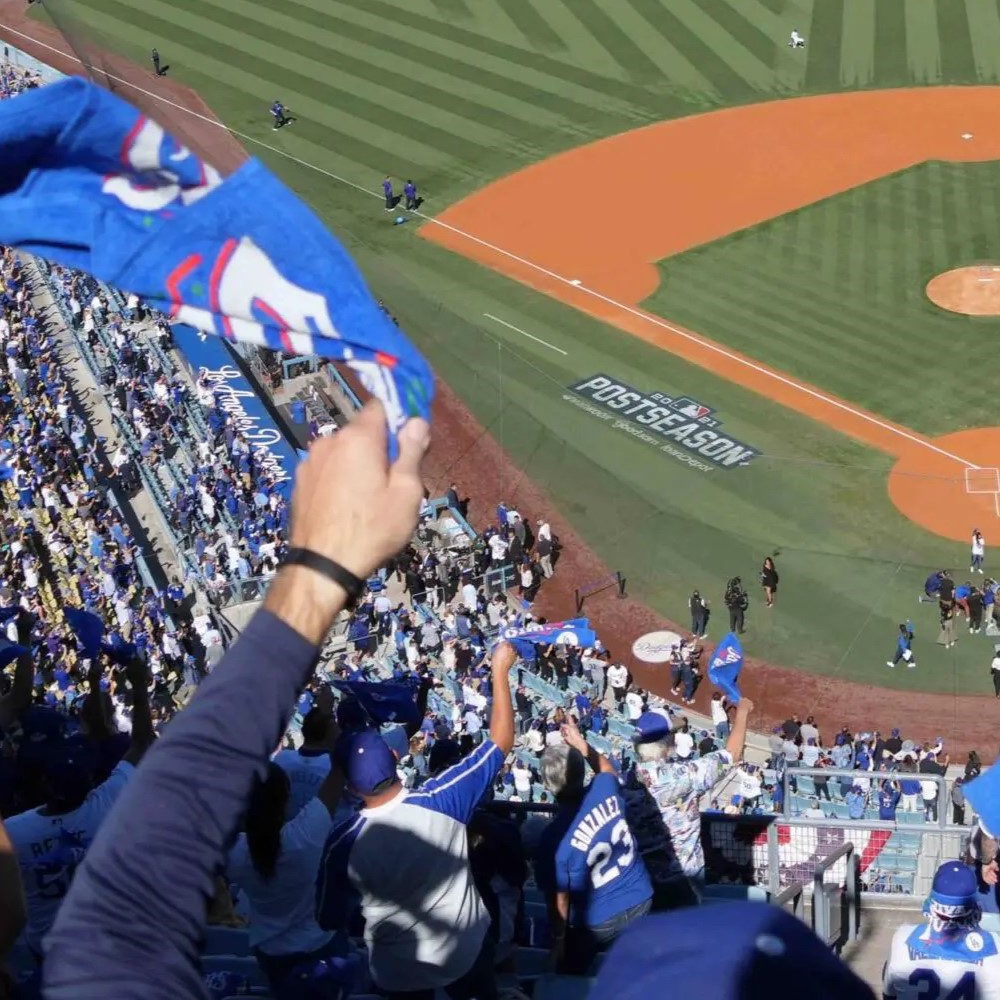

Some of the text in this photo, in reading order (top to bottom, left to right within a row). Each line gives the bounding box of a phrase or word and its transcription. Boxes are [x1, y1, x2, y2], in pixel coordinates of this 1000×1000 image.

[575, 376, 751, 466] POSTSEASON
[650, 393, 672, 405] 20
[698, 417, 718, 428] 21
[570, 795, 621, 852] GONZALEZ
[586, 818, 635, 889] 23
